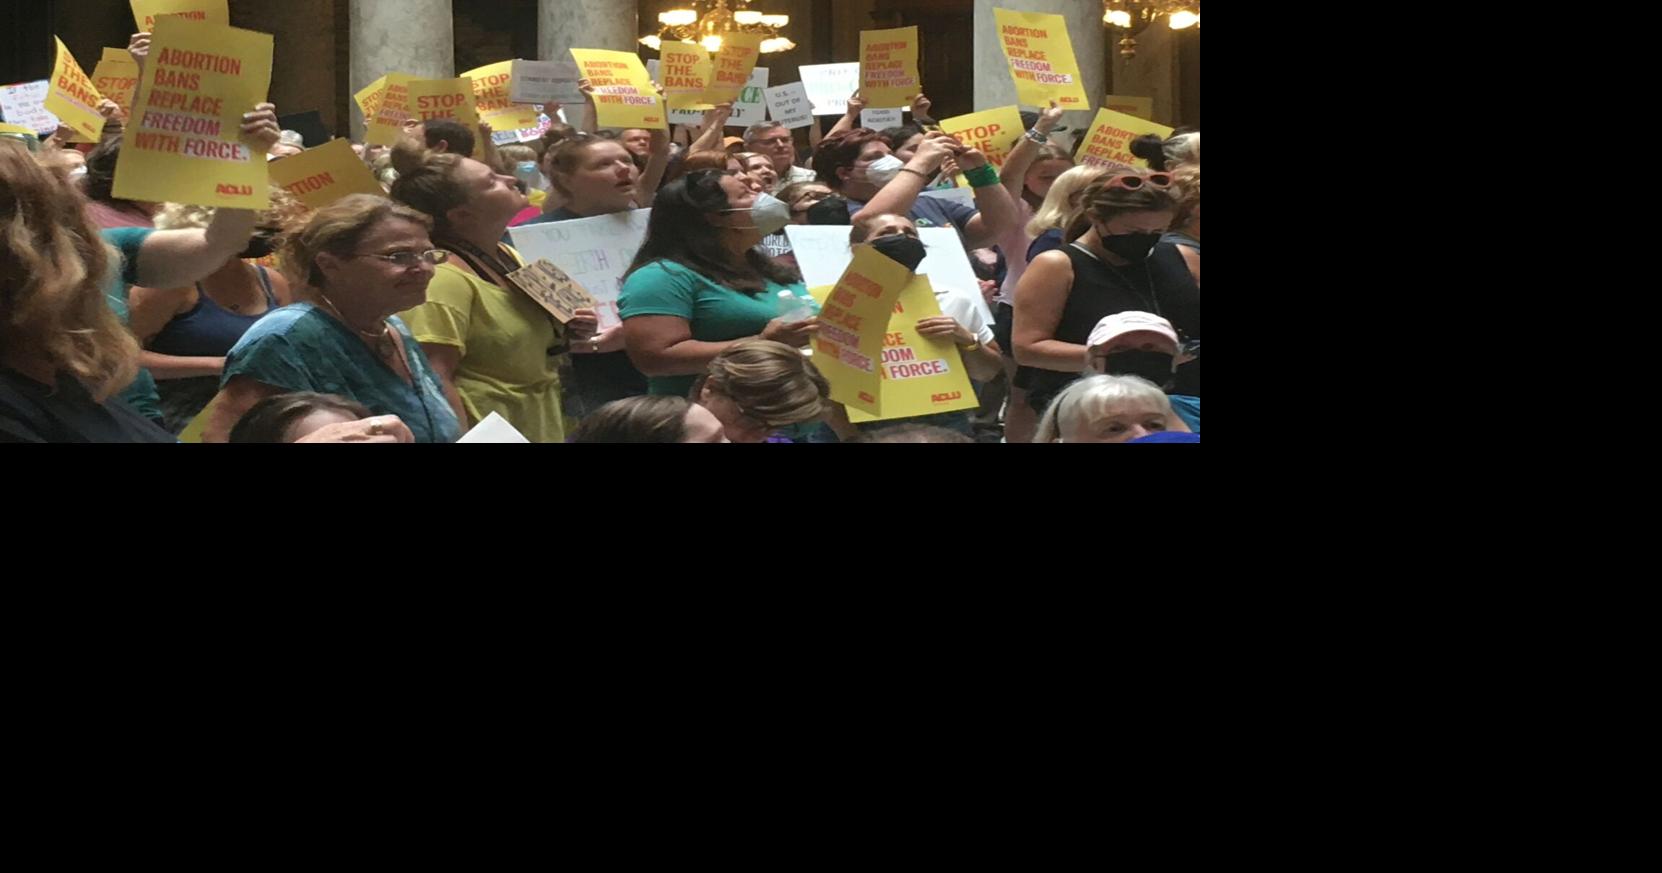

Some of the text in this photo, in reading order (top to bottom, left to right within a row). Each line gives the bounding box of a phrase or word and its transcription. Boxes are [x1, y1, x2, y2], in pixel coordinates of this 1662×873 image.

[1002, 25, 1047, 38] ABORTION
[1004, 36, 1028, 47] BANS
[158, 47, 241, 75] ABORTION
[1007, 47, 1047, 60] REPLACE
[584, 61, 629, 69] ABORTION
[1011, 59, 1051, 71] FREEDOM
[154, 68, 201, 91] BANS
[591, 79, 632, 87] REPLACE
[1014, 70, 1036, 81] WITH
[147, 89, 223, 117] REPLACE
[475, 98, 509, 112] BAN
[599, 95, 623, 104] WITH
[142, 110, 222, 136] FREEDOM
[1096, 125, 1137, 140] ABORT
[135, 132, 248, 160] WITH FORCE.
[1091, 134, 1123, 149] BANS
[1087, 144, 1137, 165] REPLACE
[215, 183, 253, 196] ACLU
[843, 271, 884, 299] ABORTION
[832, 286, 858, 308] BANS
[823, 303, 863, 332] REPLACE
[890, 360, 949, 380] FORCE.
[931, 390, 962, 403] ACLU
